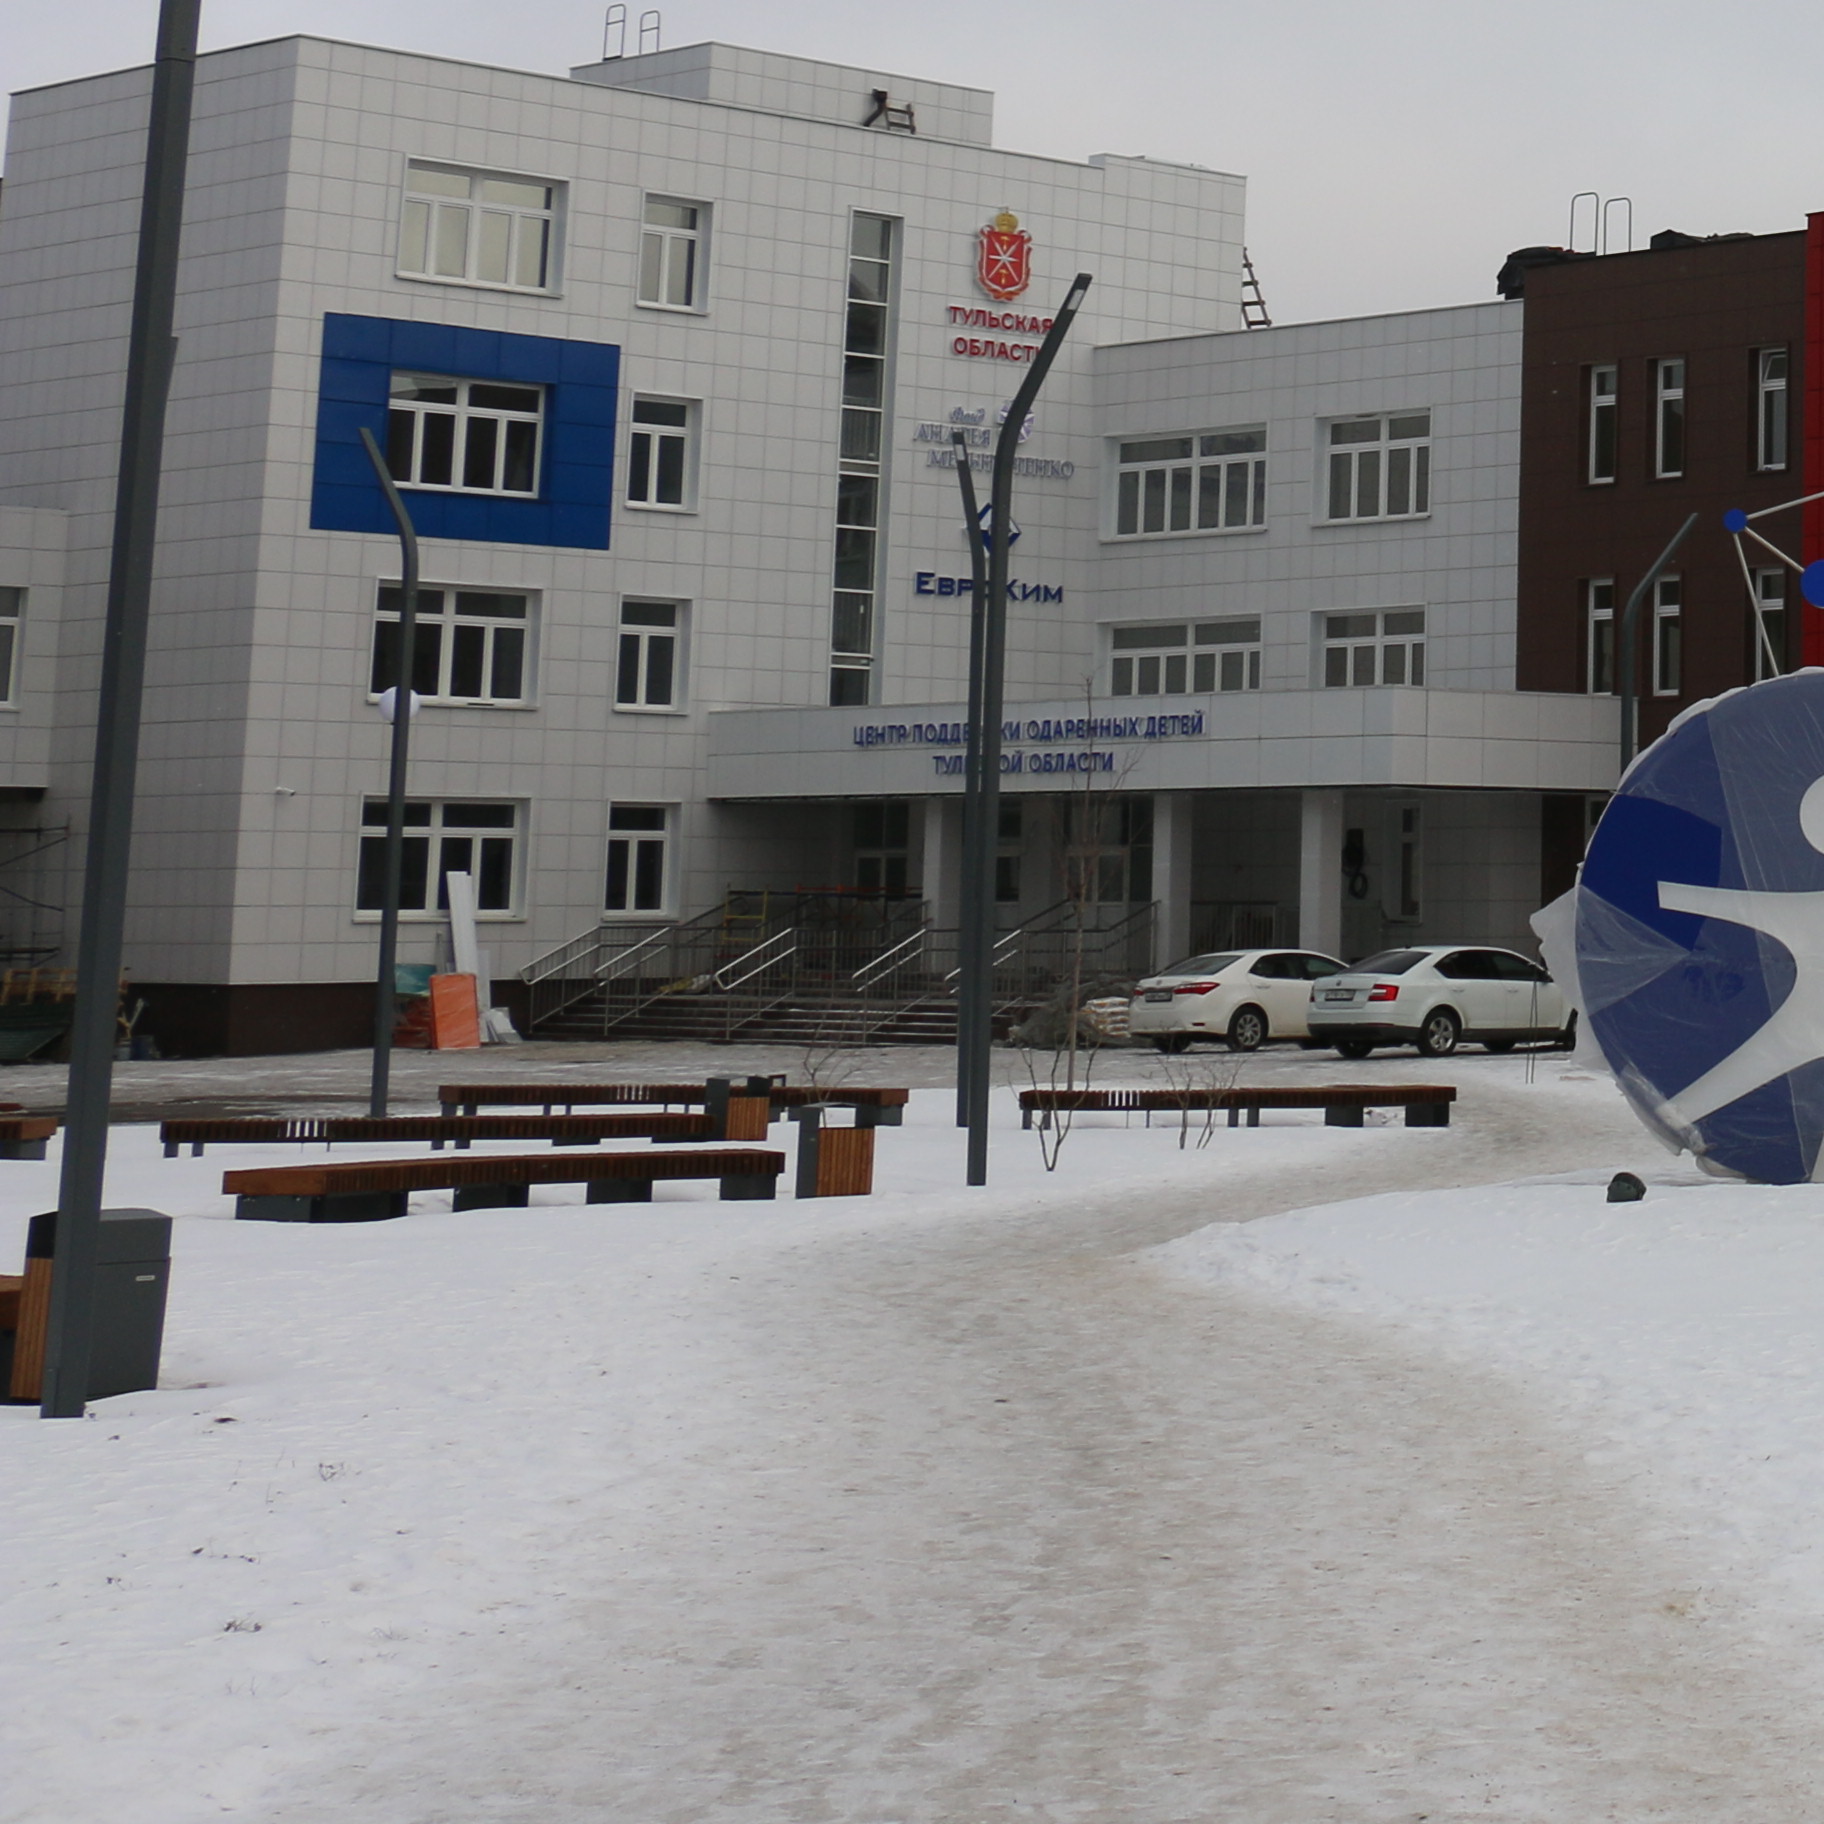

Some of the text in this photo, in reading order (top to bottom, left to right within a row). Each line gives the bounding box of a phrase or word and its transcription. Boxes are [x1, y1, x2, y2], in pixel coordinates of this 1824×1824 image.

[948, 306, 1053, 334] ТУЛЬСКАЯ
[853, 709, 1204, 747] ЦЕНТР ПОДДЕКИ ОДАРЕННЫХ ДЕТЕЙ
[933, 750, 1114, 775] ТУЛОЙ ОБЛАСТИ
